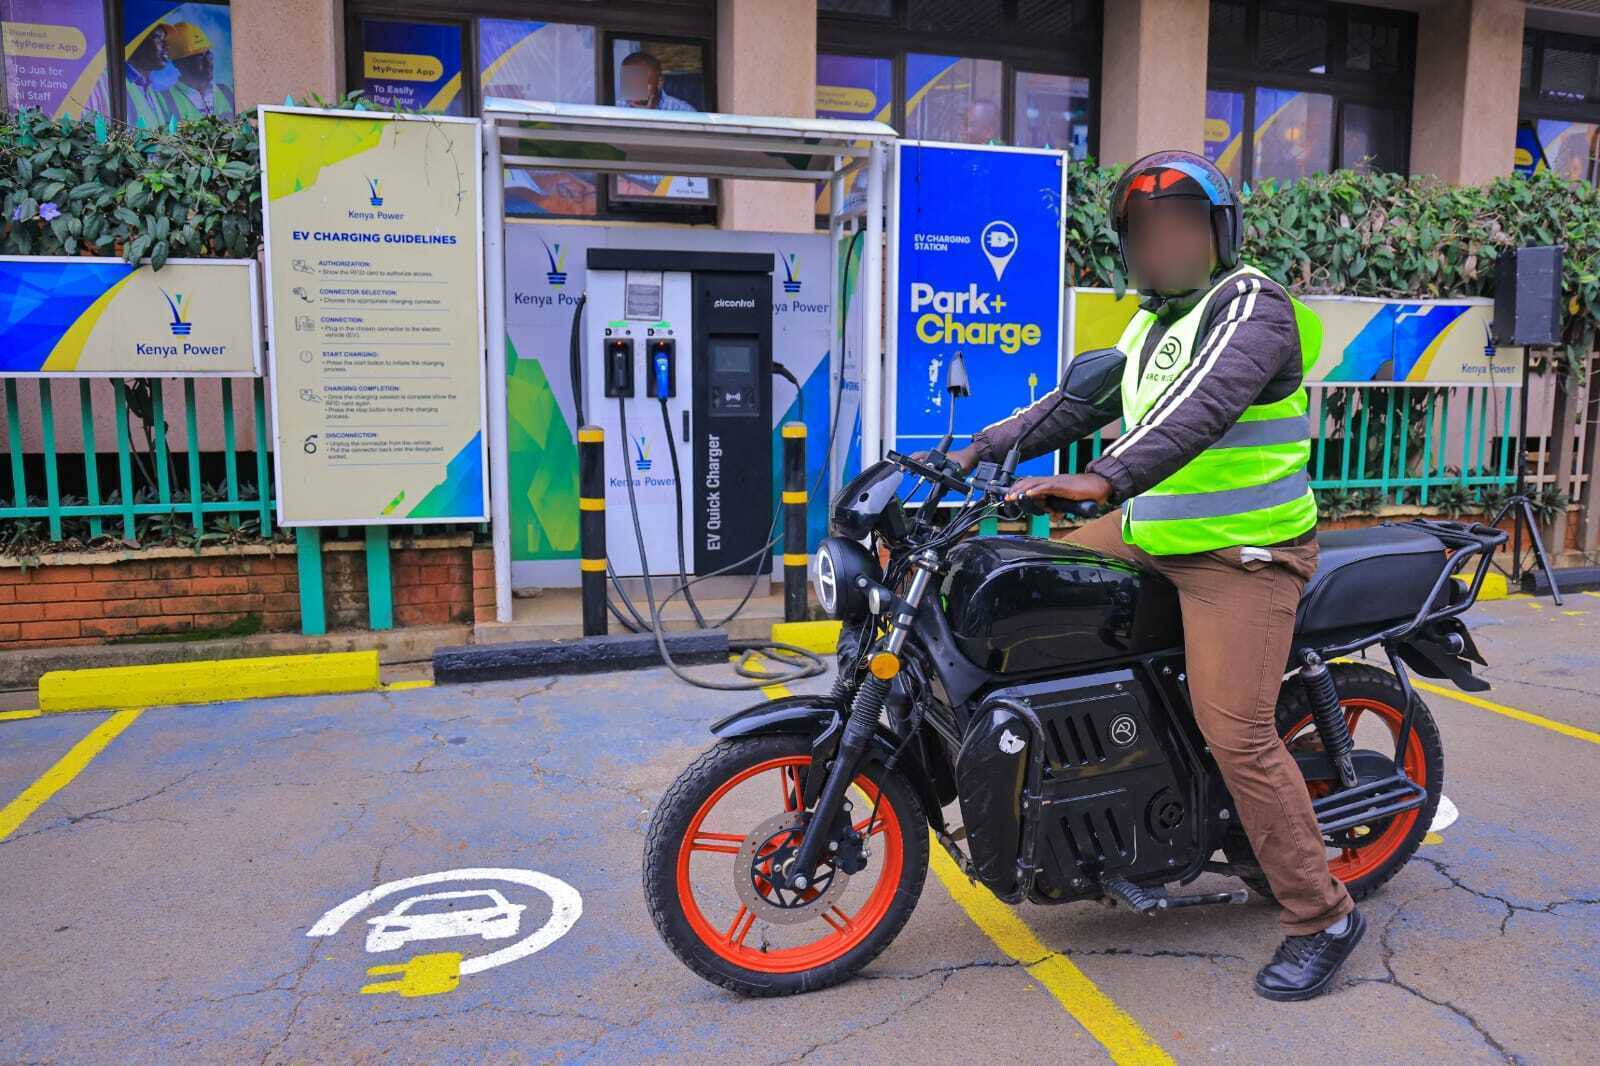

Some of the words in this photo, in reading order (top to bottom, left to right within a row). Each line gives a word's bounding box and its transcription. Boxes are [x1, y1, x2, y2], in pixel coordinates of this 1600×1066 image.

[11, 40, 55, 50] MyPower
[58, 43, 79, 54] App
[15, 64, 26, 74] To
[30, 65, 46, 75] Jua
[48, 66, 64, 76] for
[372, 66, 413, 74] MyPower
[416, 68, 436, 77] App
[14, 78, 37, 86] Sure
[40, 79, 68, 89] Kama
[28, 91, 51, 100] Staff
[374, 85, 385, 94] To
[387, 86, 414, 96] Easily
[398, 97, 415, 106] our
[348, 210, 374, 221] Kenya
[378, 211, 405, 220] Power
[293, 231, 310, 240] EV
[314, 232, 380, 243] CHARGING
[384, 234, 457, 244] GUIDELINES
[914, 234, 925, 242] EV
[927, 234, 970, 244] CHARGING
[514, 292, 552, 308] Kenya
[558, 293, 580, 305] Pow
[910, 282, 1006, 314] Park+
[793, 301, 829, 312] Power
[916, 313, 1041, 354] Charge
[137, 344, 177, 358] Kenya
[184, 344, 226, 355] Power
[1462, 363, 1487, 376] Kenya
[1490, 364, 1516, 373] Power
[706, 434, 722, 488] Charger
[645, 477, 675, 486] Power
[706, 491, 722, 530] Quick
[707, 533, 721, 550] EV
